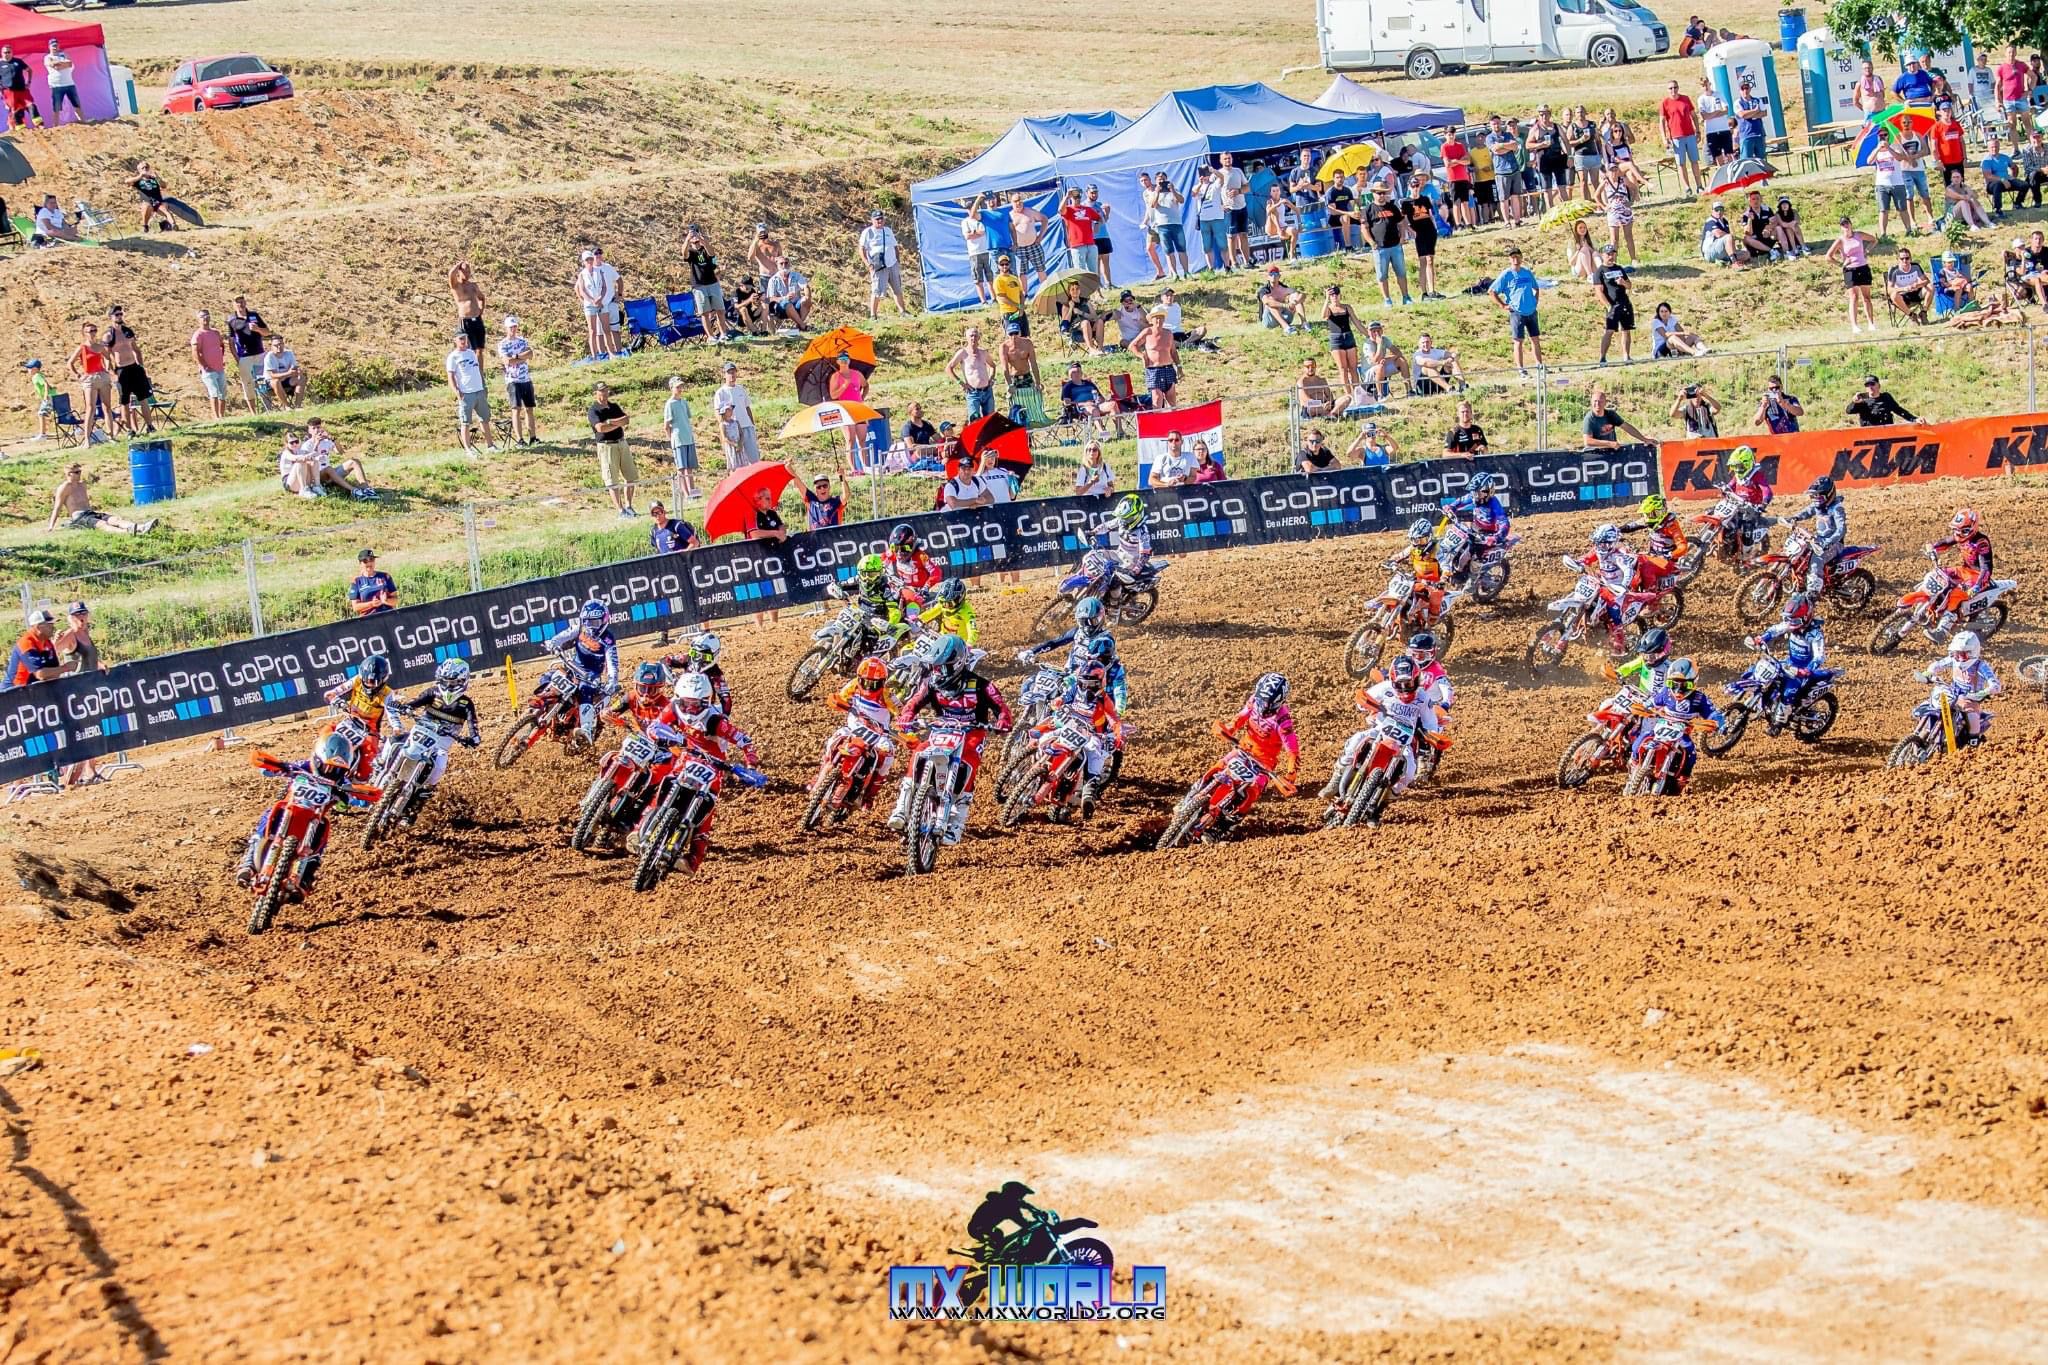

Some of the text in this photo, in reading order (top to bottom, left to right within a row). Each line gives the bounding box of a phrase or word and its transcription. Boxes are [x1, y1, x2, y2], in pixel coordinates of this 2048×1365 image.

[1986, 424, 2048, 469] KT
[1829, 436, 1940, 481] KTM
[1528, 461, 1648, 487] GoPro
[1391, 472, 1509, 499] GoPo
[1260, 485, 1375, 512] GoPro
[1531, 495, 1541, 503] Be
[1548, 491, 1576, 501] HERO.
[1282, 515, 1308, 527] HERO.
[922, 523, 1004, 550] oPro
[1156, 529, 1181, 540] HERO.
[1038, 540, 1060, 552] HERO.
[691, 556, 783, 588] GoPro
[589, 574, 680, 606] GoPro
[711, 591, 733, 604] HERO.
[488, 595, 579, 630] GoPro
[394, 615, 479, 650] GoPro
[507, 632, 528, 647] HERO.
[306, 635, 388, 669] GoPro
[915, 639, 931, 655] 55
[415, 652, 434, 667] HERO.
[222, 654, 302, 687] GoPro
[137, 671, 217, 705] GoPro
[552, 675, 577, 695] 467
[67, 686, 134, 720] GoPro
[1060, 727, 1088, 748] 589
[1382, 724, 1410, 745] 424
[1656, 727, 1680, 740] 474
[625, 740, 651, 760] 529
[685, 762, 714, 783] 484
[1228, 759, 1254, 780] 592
[294, 786, 329, 805] 503
